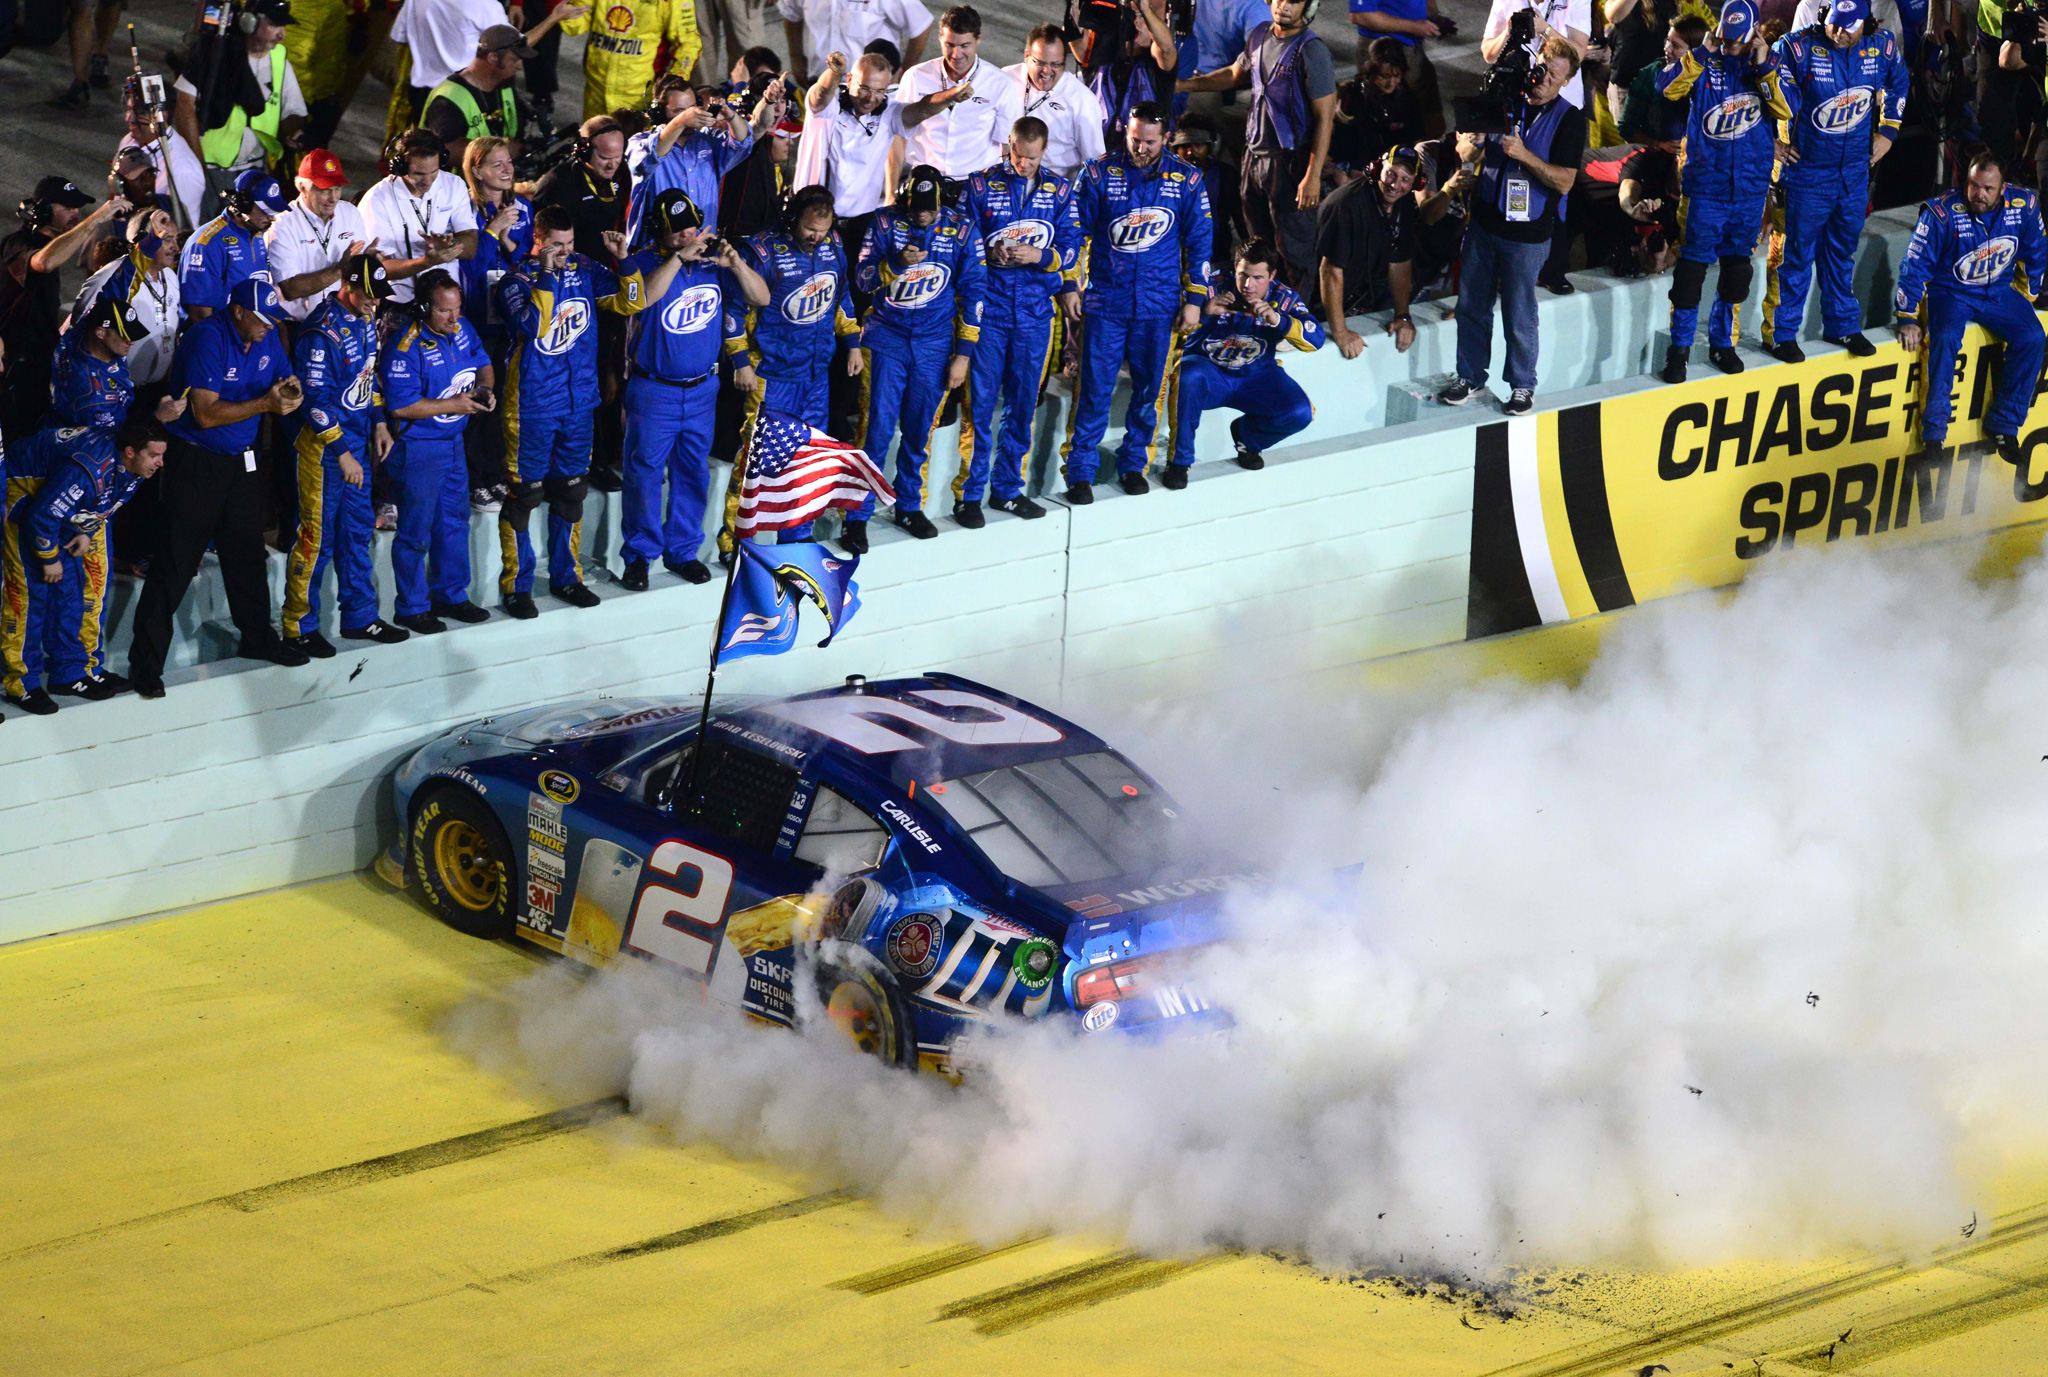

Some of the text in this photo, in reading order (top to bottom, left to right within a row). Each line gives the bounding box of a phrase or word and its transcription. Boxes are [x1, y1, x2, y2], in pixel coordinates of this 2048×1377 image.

[590, 30, 643, 56] PENNZOIL
[1721, 99, 1750, 114] Miller
[1825, 98, 1868, 128] Lite
[1834, 93, 1861, 107] Miller
[1712, 104, 1760, 135] Lite
[1003, 226, 1036, 240] Miller
[1127, 213, 1158, 226] Miller
[1116, 220, 1164, 247] Lite
[1965, 247, 2012, 281] Lite
[1973, 242, 2004, 260] Miller
[801, 278, 827, 297] Miller
[891, 275, 940, 302] Lite
[904, 269, 934, 281] Miller
[682, 291, 707, 307] Miller
[795, 283, 834, 320] Lite
[103, 320, 111, 328] 2
[676, 299, 714, 330] Lite
[550, 309, 584, 350] Lite
[227, 367, 237, 377] 2
[1657, 363, 1900, 481] CHASE
[1905, 352, 1967, 393] FR
[1902, 393, 1960, 433] TE
[1734, 438, 1999, 559] SPRINT
[84, 552, 103, 598] Miller
[722, 612, 782, 650] 2
[750, 688, 1066, 756] 2
[713, 720, 807, 759] BRAD KESELOWSKI
[430, 766, 488, 795] GOODYEAR
[550, 780, 567, 792] Sprint
[529, 812, 567, 840] MAHLE
[880, 799, 942, 854] CARLISLE
[412, 801, 441, 906] GOODYEAR
[529, 829, 565, 853] MOOG
[529, 865, 557, 883] LINCOLN
[537, 857, 563, 876] freescale
[528, 884, 554, 914] 3M
[626, 837, 737, 975] 2
[894, 915, 916, 932] TRIPLE
[980, 905, 1037, 937] Miller
[1026, 936, 1061, 960] AMERICAN
[753, 956, 794, 984] SKF
[1014, 966, 1051, 988] ETHANOL
[749, 977, 794, 1003] DISCOUN
[763, 995, 785, 1011] TIRE
[1089, 1005, 1114, 1031] Lite
